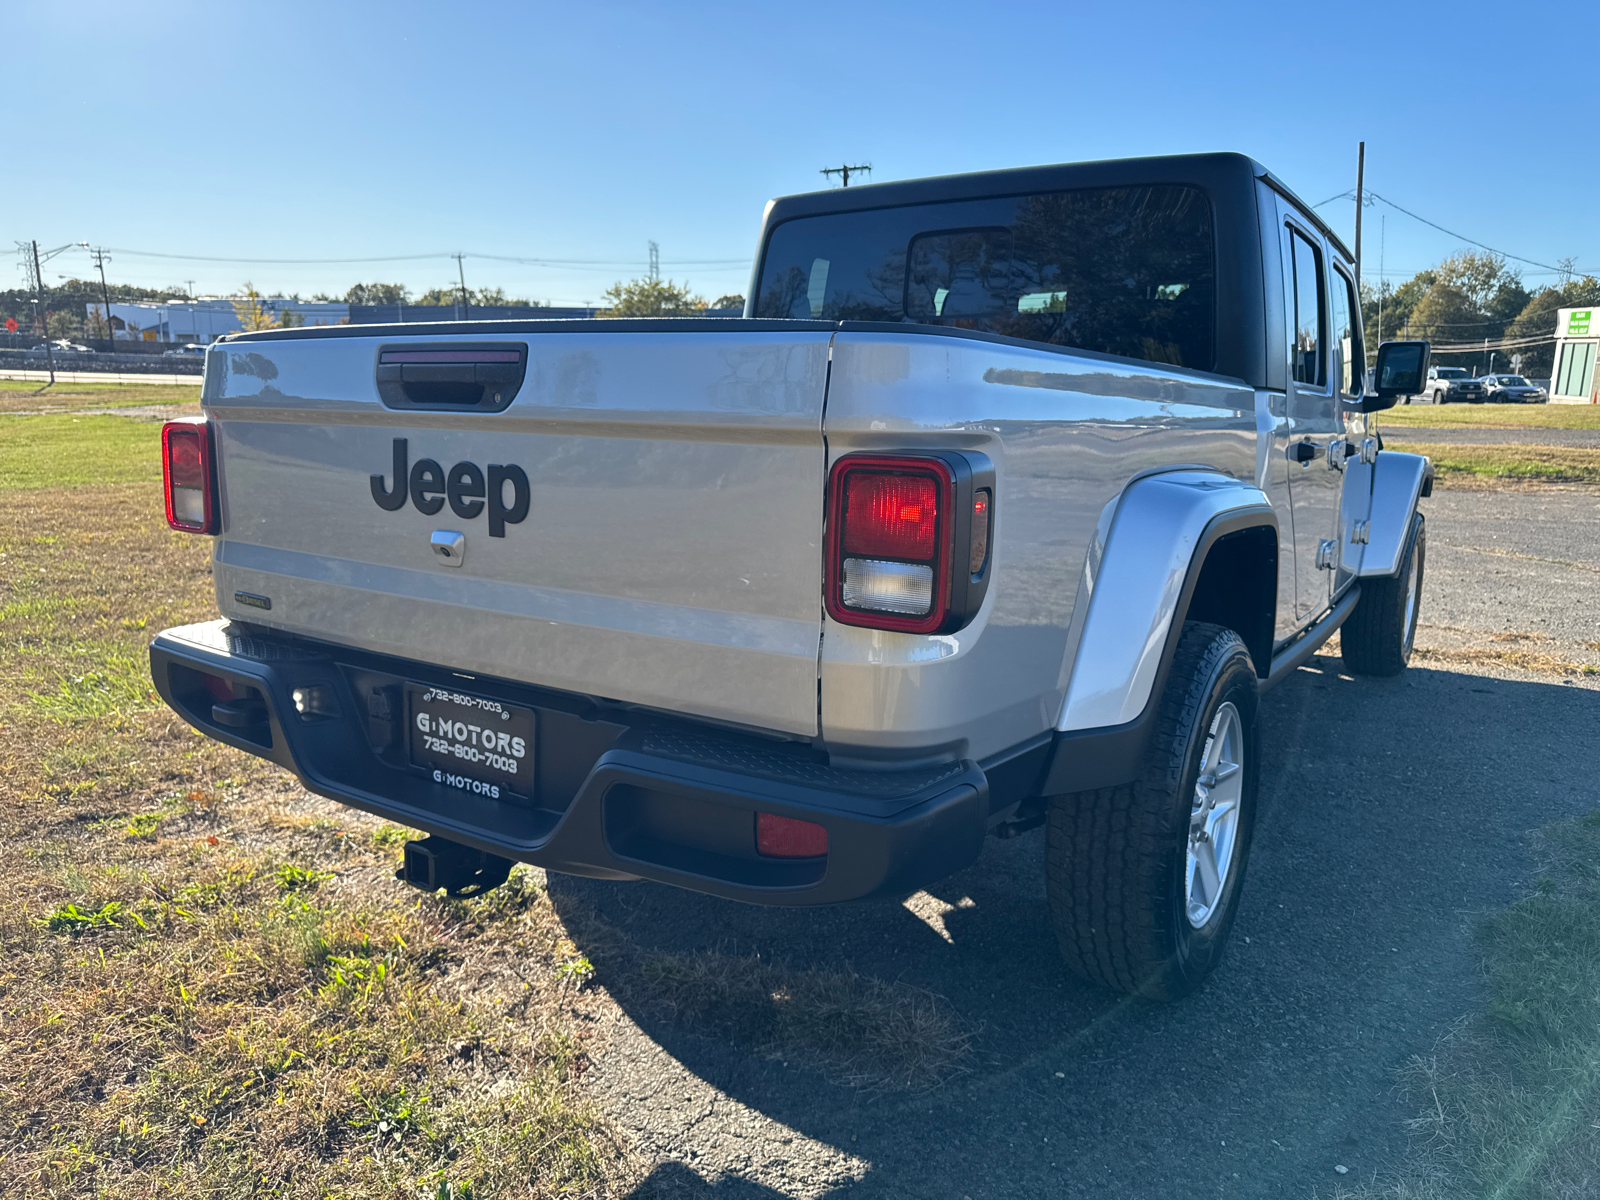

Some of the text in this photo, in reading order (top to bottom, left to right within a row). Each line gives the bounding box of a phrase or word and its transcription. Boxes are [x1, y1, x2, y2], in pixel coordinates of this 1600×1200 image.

[370, 437, 531, 538] Jeep
[429, 688, 502, 713] 732-800-7003
[423, 735, 518, 774] 732-800-7003
